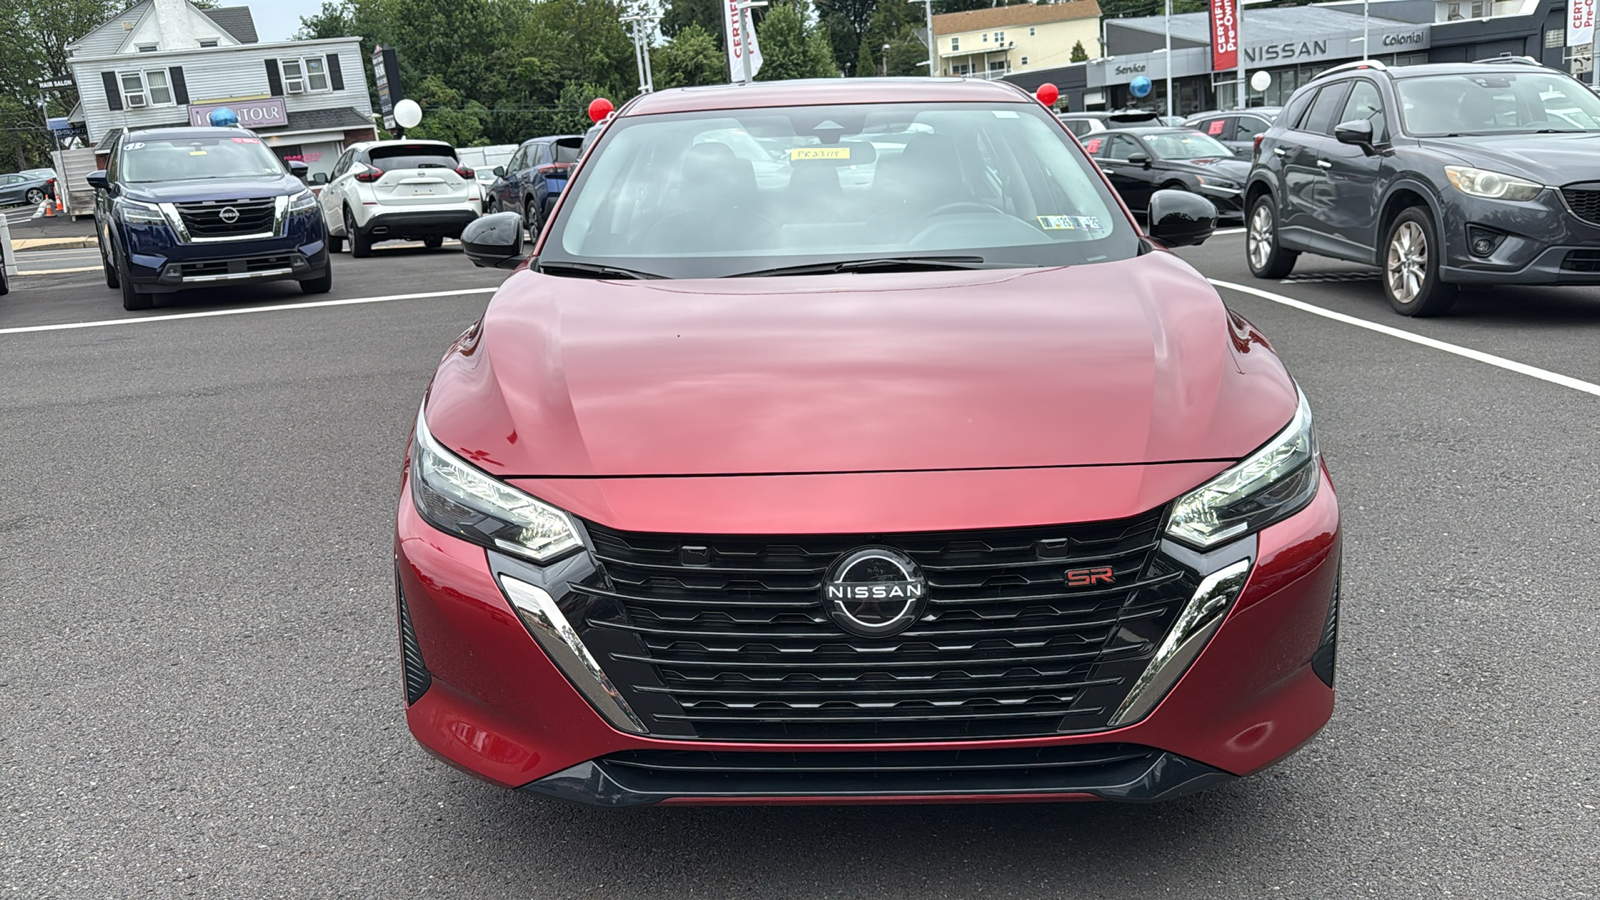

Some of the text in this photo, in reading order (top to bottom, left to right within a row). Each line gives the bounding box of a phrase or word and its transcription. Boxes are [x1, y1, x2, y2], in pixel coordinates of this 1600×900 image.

[1383, 31, 1424, 46] Colonial
[1243, 40, 1326, 62] NISSAN
[1115, 63, 1146, 75] Service
[54, 79, 73, 87] SALON
[1067, 567, 1114, 586] SR
[829, 583, 921, 598] NISSAN
